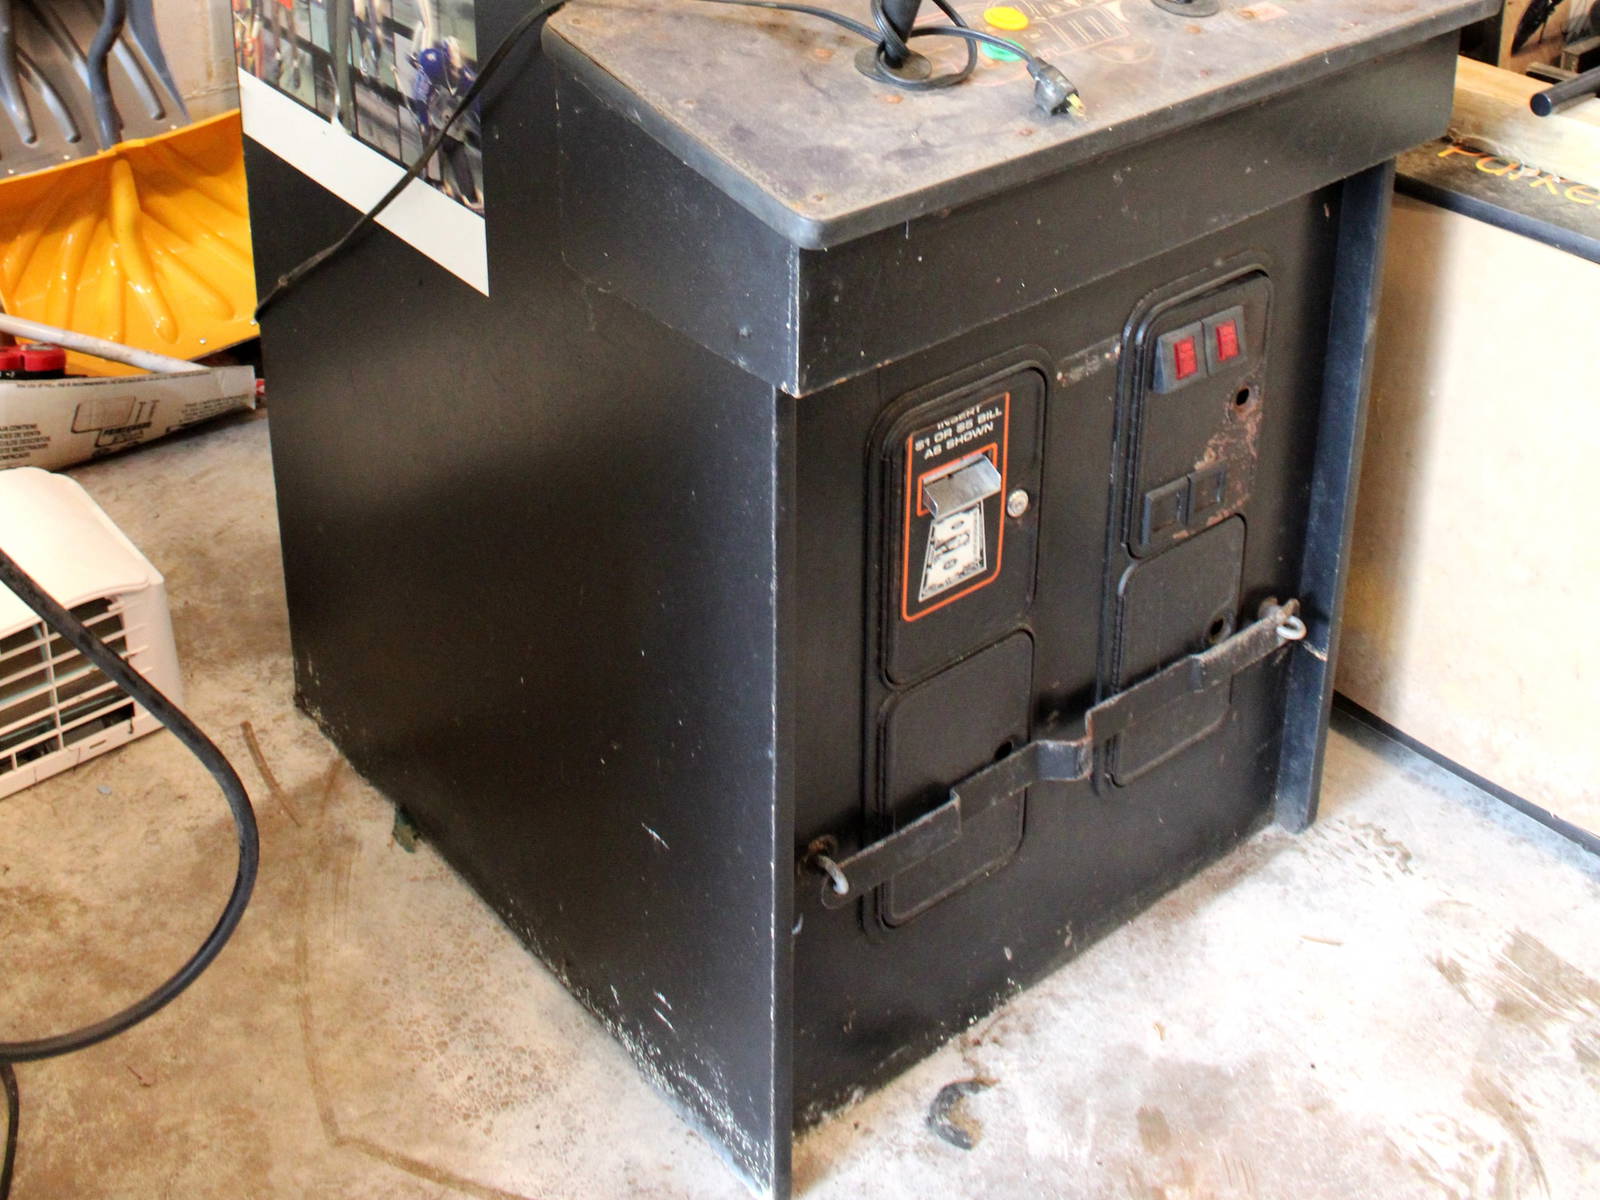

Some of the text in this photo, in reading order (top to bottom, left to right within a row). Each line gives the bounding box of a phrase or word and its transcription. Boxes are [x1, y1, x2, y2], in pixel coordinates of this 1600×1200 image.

[924, 421, 994, 460] AS SHOWN
[934, 427, 953, 443] OR
[977, 406, 1002, 425] BILL
